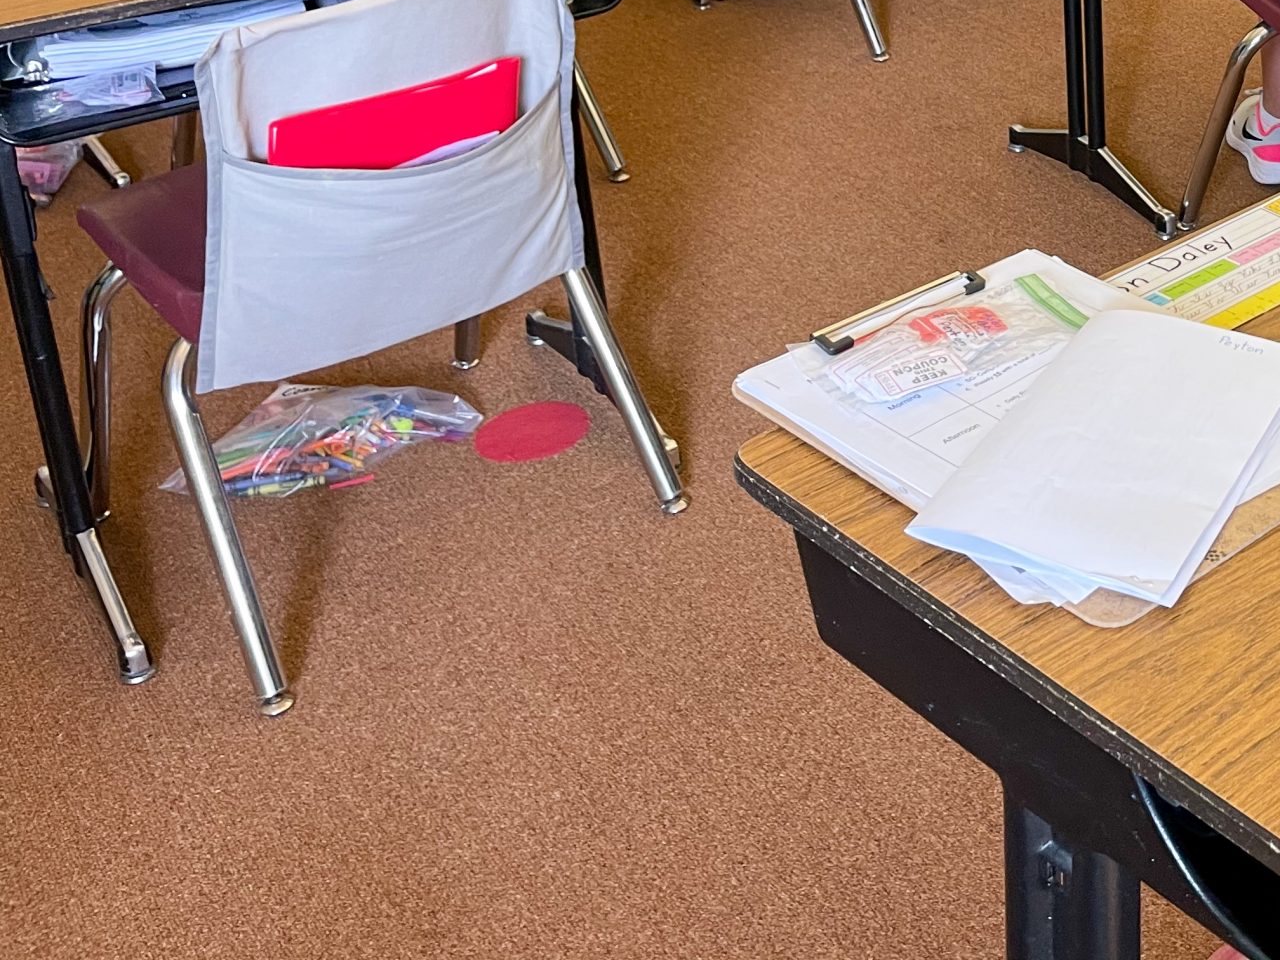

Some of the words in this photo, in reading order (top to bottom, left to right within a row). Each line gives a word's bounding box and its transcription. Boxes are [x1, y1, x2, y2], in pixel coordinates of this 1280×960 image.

[1148, 236, 1232, 272] Daley
[1218, 335, 1265, 355] Peyton
[892, 356, 948, 377] COUPON
[912, 368, 948, 384] KEEP
[887, 393, 922, 411] Morning
[942, 423, 981, 444] Afternoon
